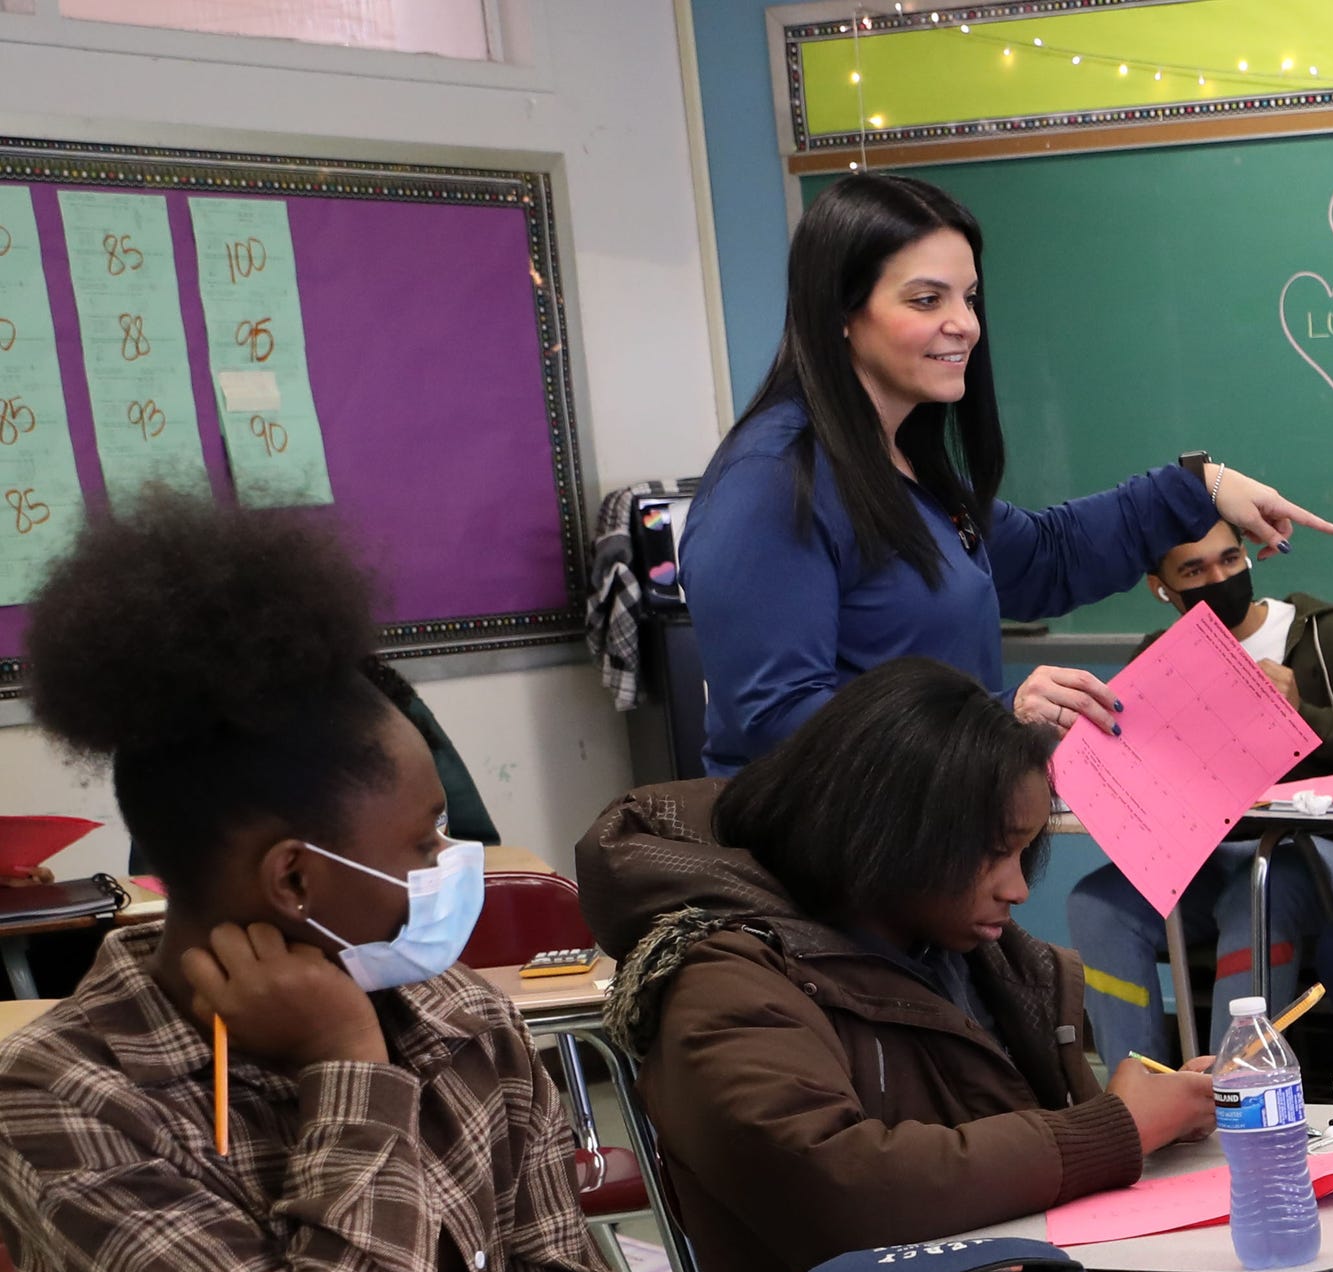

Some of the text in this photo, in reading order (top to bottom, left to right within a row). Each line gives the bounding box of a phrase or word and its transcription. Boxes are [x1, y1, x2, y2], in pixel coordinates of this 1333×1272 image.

[102, 233, 144, 276] 85
[226, 238, 267, 284] 100
[118, 313, 151, 361] 88
[234, 318, 275, 363] 95
[127, 400, 166, 441] 93
[250, 414, 288, 457] 90
[5, 487, 51, 534] 85
